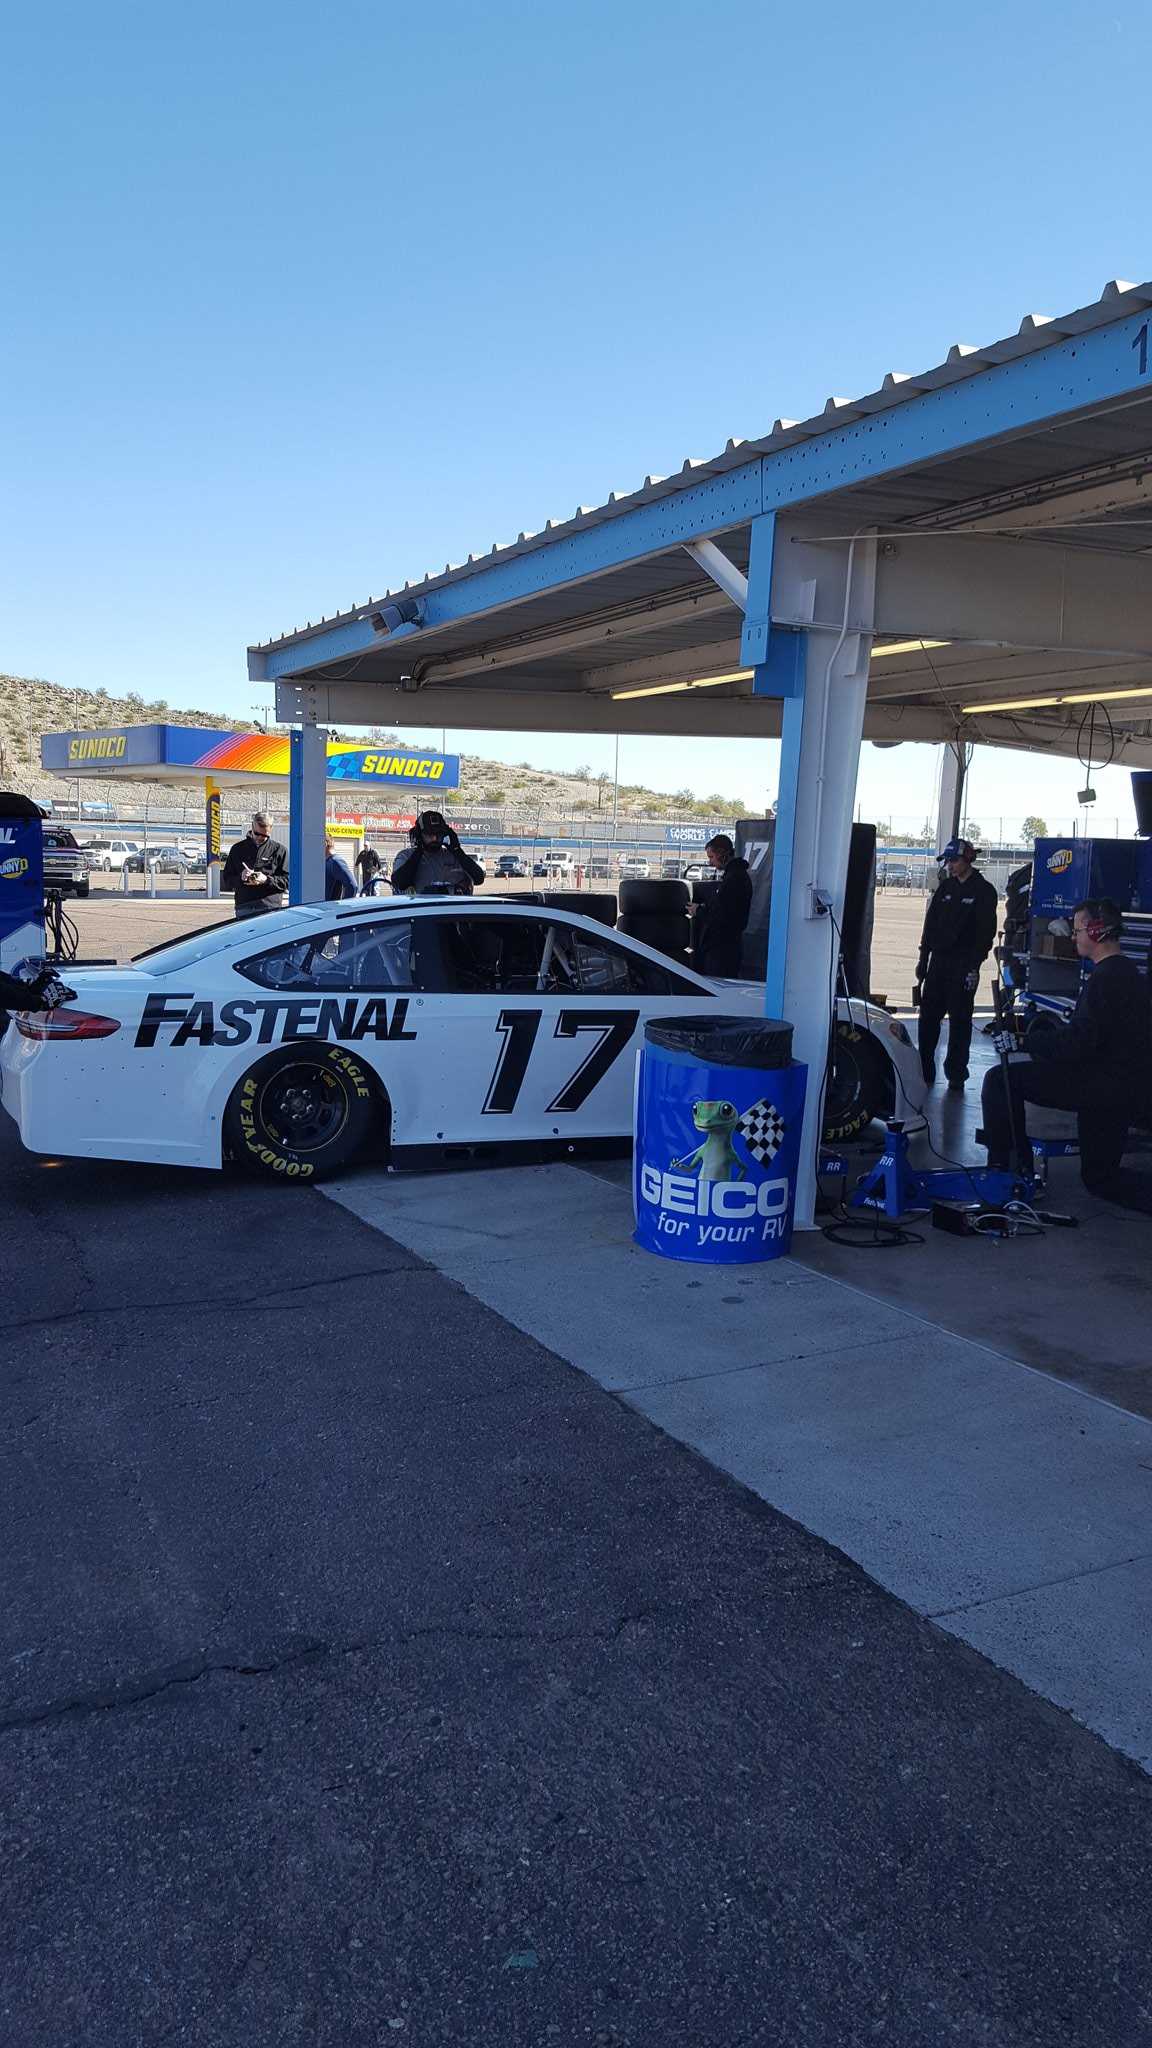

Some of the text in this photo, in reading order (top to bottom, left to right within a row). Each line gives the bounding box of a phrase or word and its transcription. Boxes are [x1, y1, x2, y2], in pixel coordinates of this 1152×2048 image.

[68, 736, 128, 760] SUNOCO
[361, 754, 445, 779] SUNOCO
[211, 801, 220, 856] SUNOCO
[341, 827, 363, 835] CENTER
[464, 824, 491, 832] zero
[743, 841, 770, 871] 17
[134, 993, 418, 1048] FASTENAL
[328, 1048, 371, 1098] EAGLE
[480, 1009, 640, 1115] 17
[239, 1078, 314, 1177] GOODYEAR
[826, 1161, 841, 1172] RR
[879, 1155, 894, 1167] RR
[641, 1163, 789, 1219] GEICO
[657, 1212, 788, 1246] for your RV
